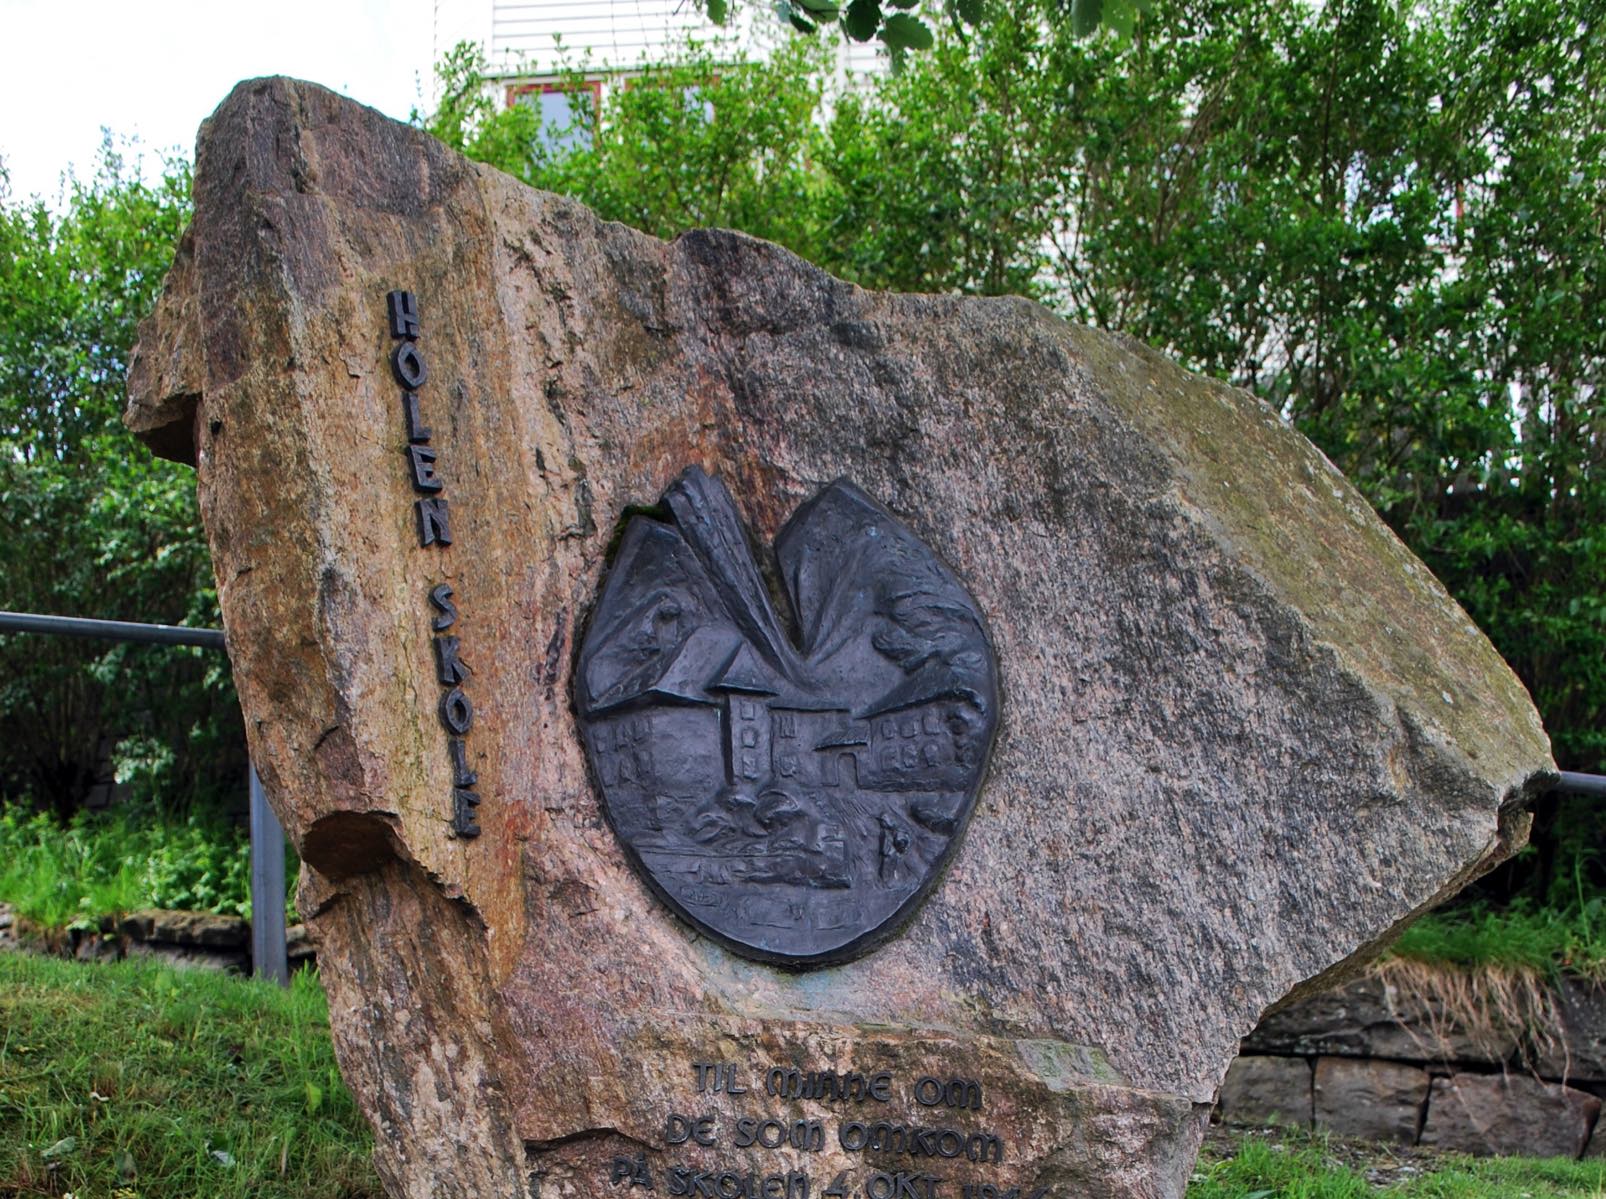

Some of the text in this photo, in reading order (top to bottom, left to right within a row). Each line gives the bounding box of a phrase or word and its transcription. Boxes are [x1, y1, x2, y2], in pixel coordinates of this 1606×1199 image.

[386, 290, 482, 839] HOLEN SKOLE
[693, 1061, 983, 1111] TIL MINNE OM
[664, 1114, 1005, 1163] DE SOM OMKOM
[610, 1153, 653, 1190] PÅ
